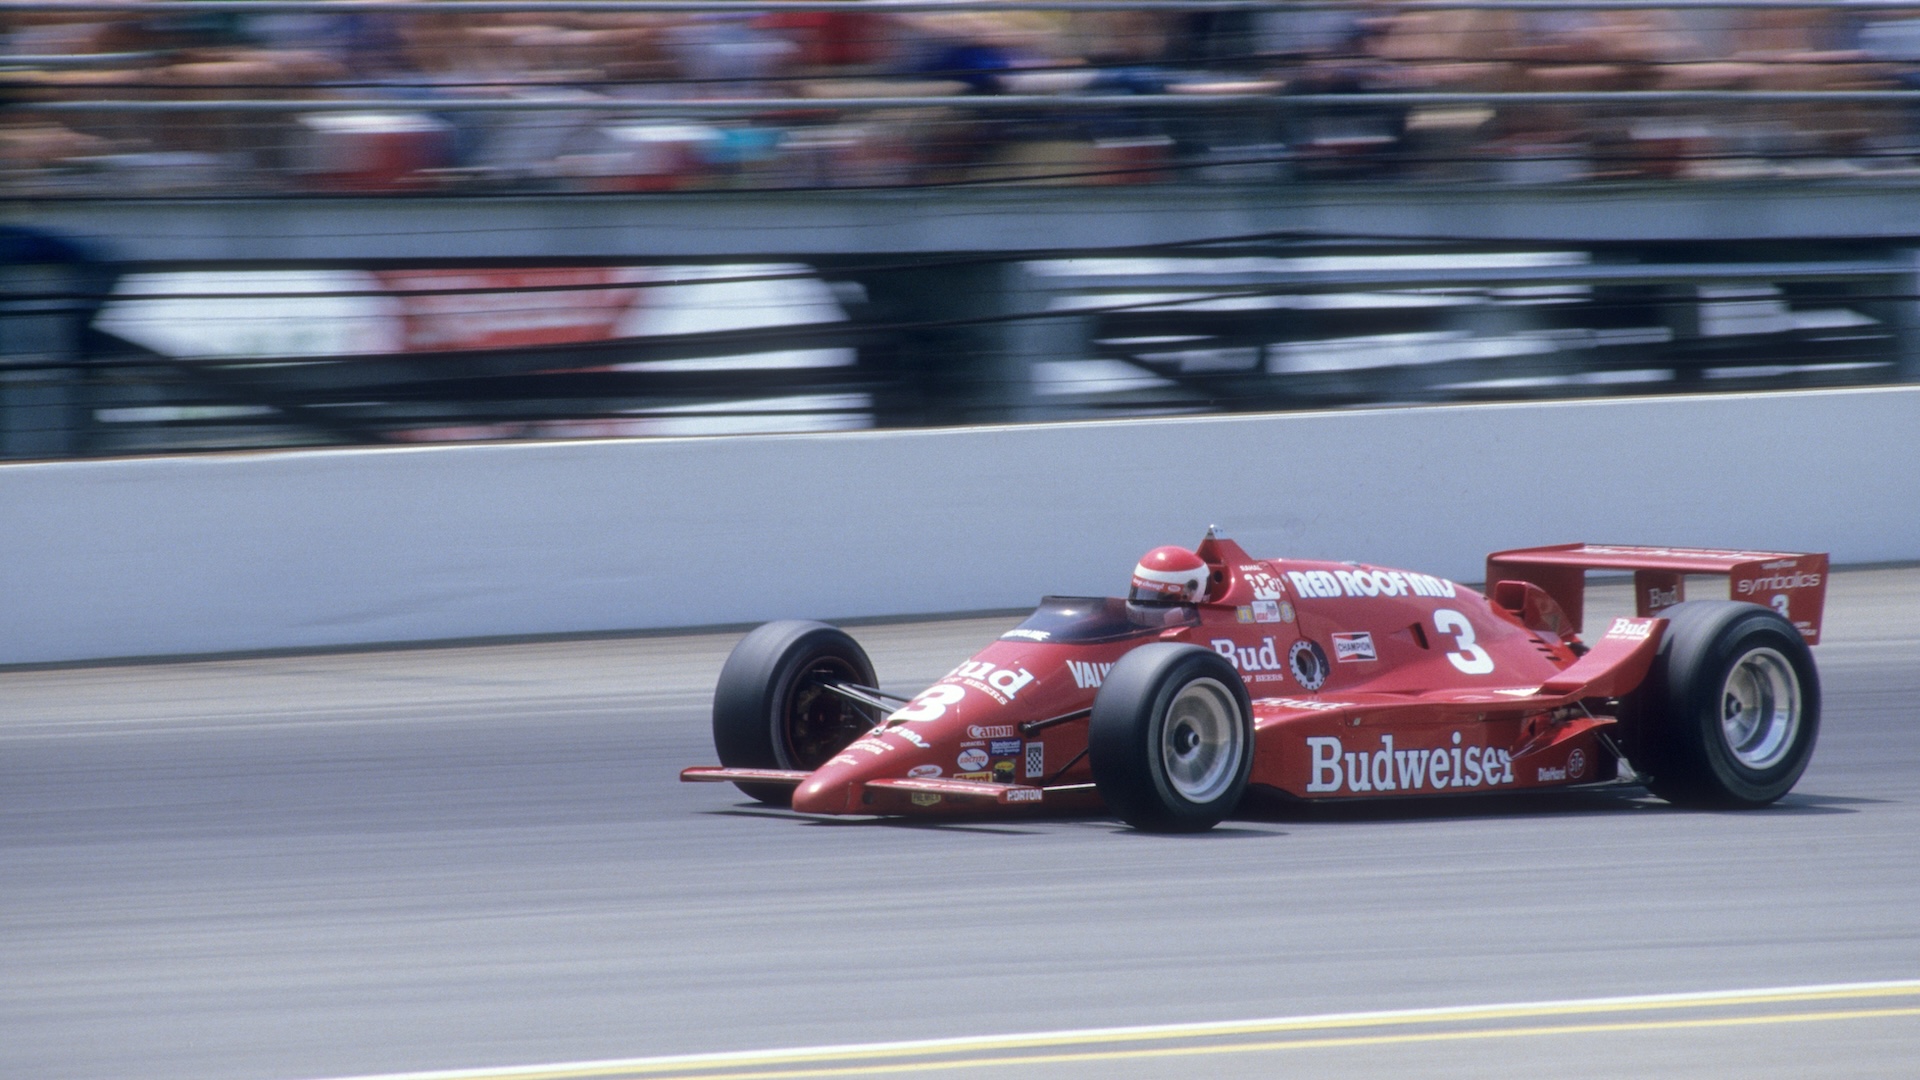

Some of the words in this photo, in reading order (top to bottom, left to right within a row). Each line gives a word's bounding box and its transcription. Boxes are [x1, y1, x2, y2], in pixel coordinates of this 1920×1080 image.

[1287, 571, 1341, 598] RED
[1334, 570, 1409, 598] ROOF
[1738, 571, 1821, 596] symbolics
[1608, 618, 1653, 635] Bud
[1210, 636, 1281, 672] Bud
[1337, 642, 1371, 652] CHAMPION
[1433, 609, 1494, 675] 3
[952, 659, 1035, 701] ud
[963, 677, 1008, 706] BEERS
[1255, 673, 1284, 682] BEERS
[886, 683, 966, 723] 3
[967, 725, 1013, 739] Canon
[1306, 731, 1514, 793] Budweiser
